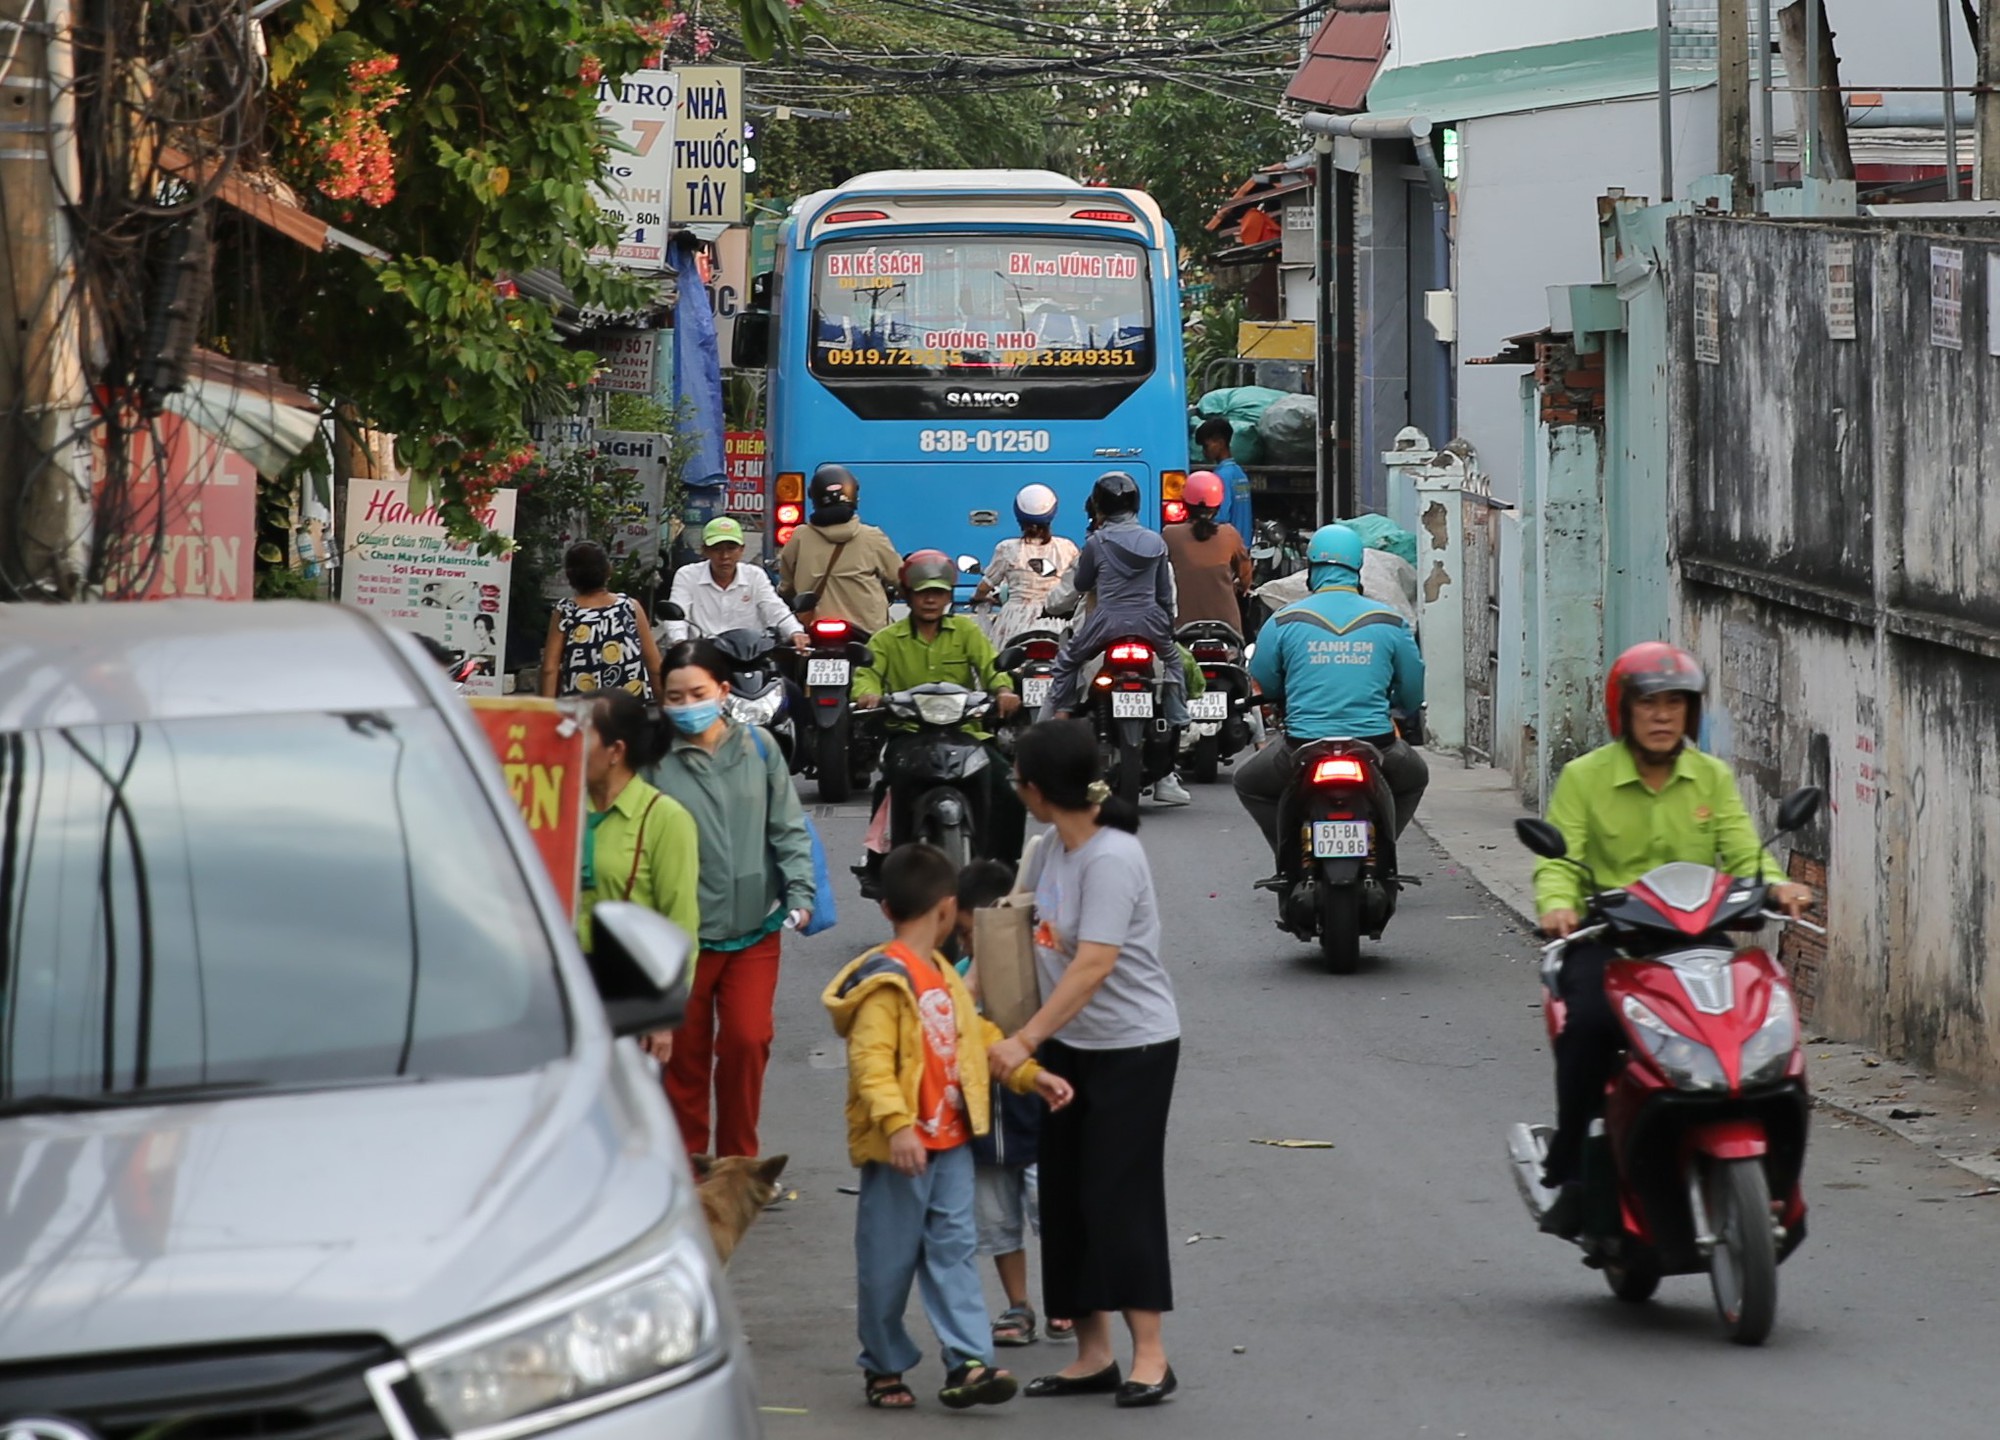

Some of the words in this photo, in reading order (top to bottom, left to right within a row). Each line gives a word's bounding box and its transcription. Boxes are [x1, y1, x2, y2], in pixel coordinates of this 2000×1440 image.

[622, 83, 673, 112] TRỌ
[686, 80, 728, 120] NHÀ
[675, 128, 739, 169] THUỐC
[686, 175, 726, 216] TÂY
[637, 212, 660, 225] 80h
[828, 255, 851, 276] BX
[878, 250, 923, 275] SÁCH
[1009, 253, 1032, 275] BX
[1105, 253, 1137, 279] TÀU
[624, 335, 642, 354] SỐ
[645, 340, 652, 354] 7
[947, 392, 1020, 408] SAMCO
[920, 430, 1050, 452] 83B-01250
[734, 460, 745, 477] XE
[410, 566, 434, 577] Sexy
[435, 568, 466, 578] Brows
[1308, 641, 1349, 653] XANH
[1352, 642, 1374, 653] SM
[1309, 653, 1330, 665] xin
